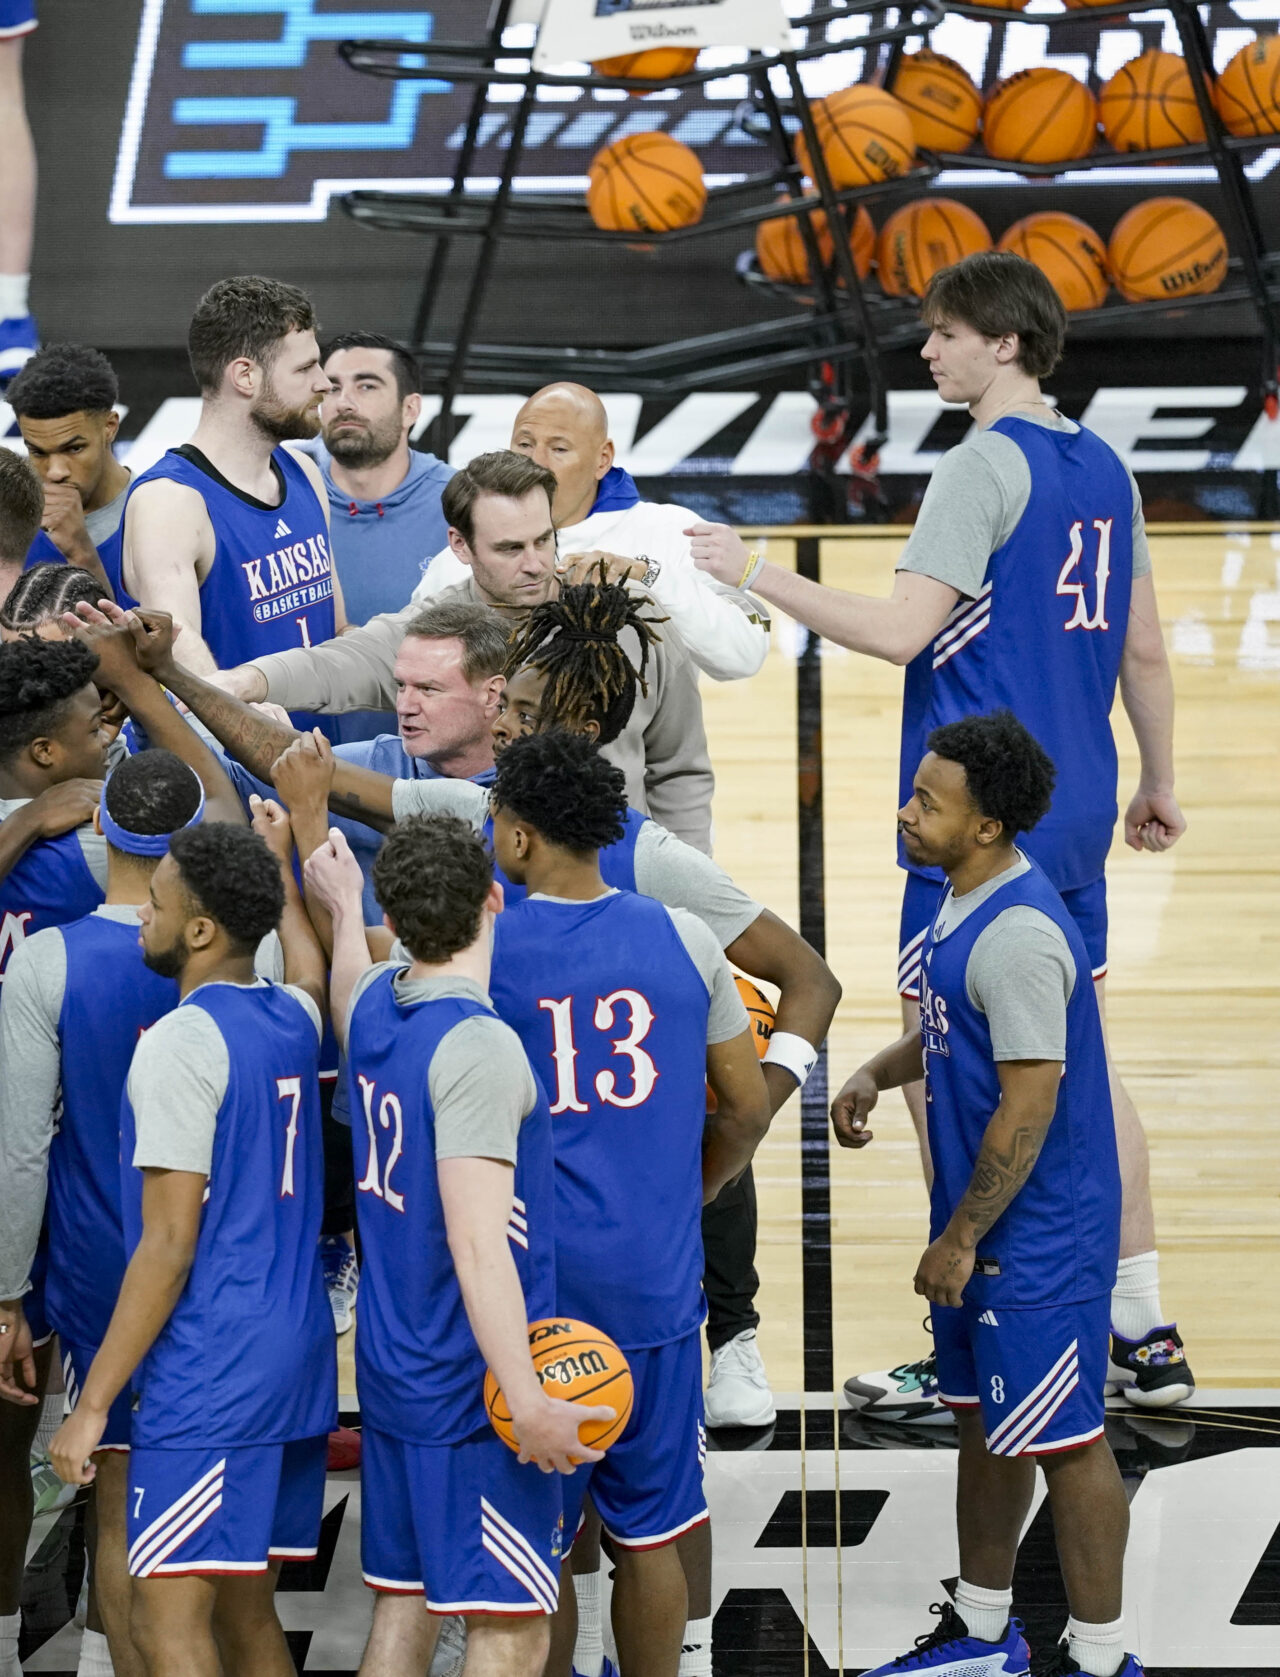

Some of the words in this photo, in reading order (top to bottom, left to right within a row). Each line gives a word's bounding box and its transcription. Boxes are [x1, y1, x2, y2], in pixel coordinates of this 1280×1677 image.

[241, 533, 330, 601] KANSAS
[261, 579, 333, 619] BASKETBALL
[1056, 518, 1113, 631] 41
[537, 987, 661, 1116] 13
[275, 1074, 301, 1200] 7
[357, 1073, 405, 1214] 12
[535, 1349, 609, 1385] Wils
[990, 1374, 1005, 1404] 8
[133, 1486, 145, 1519] 7
